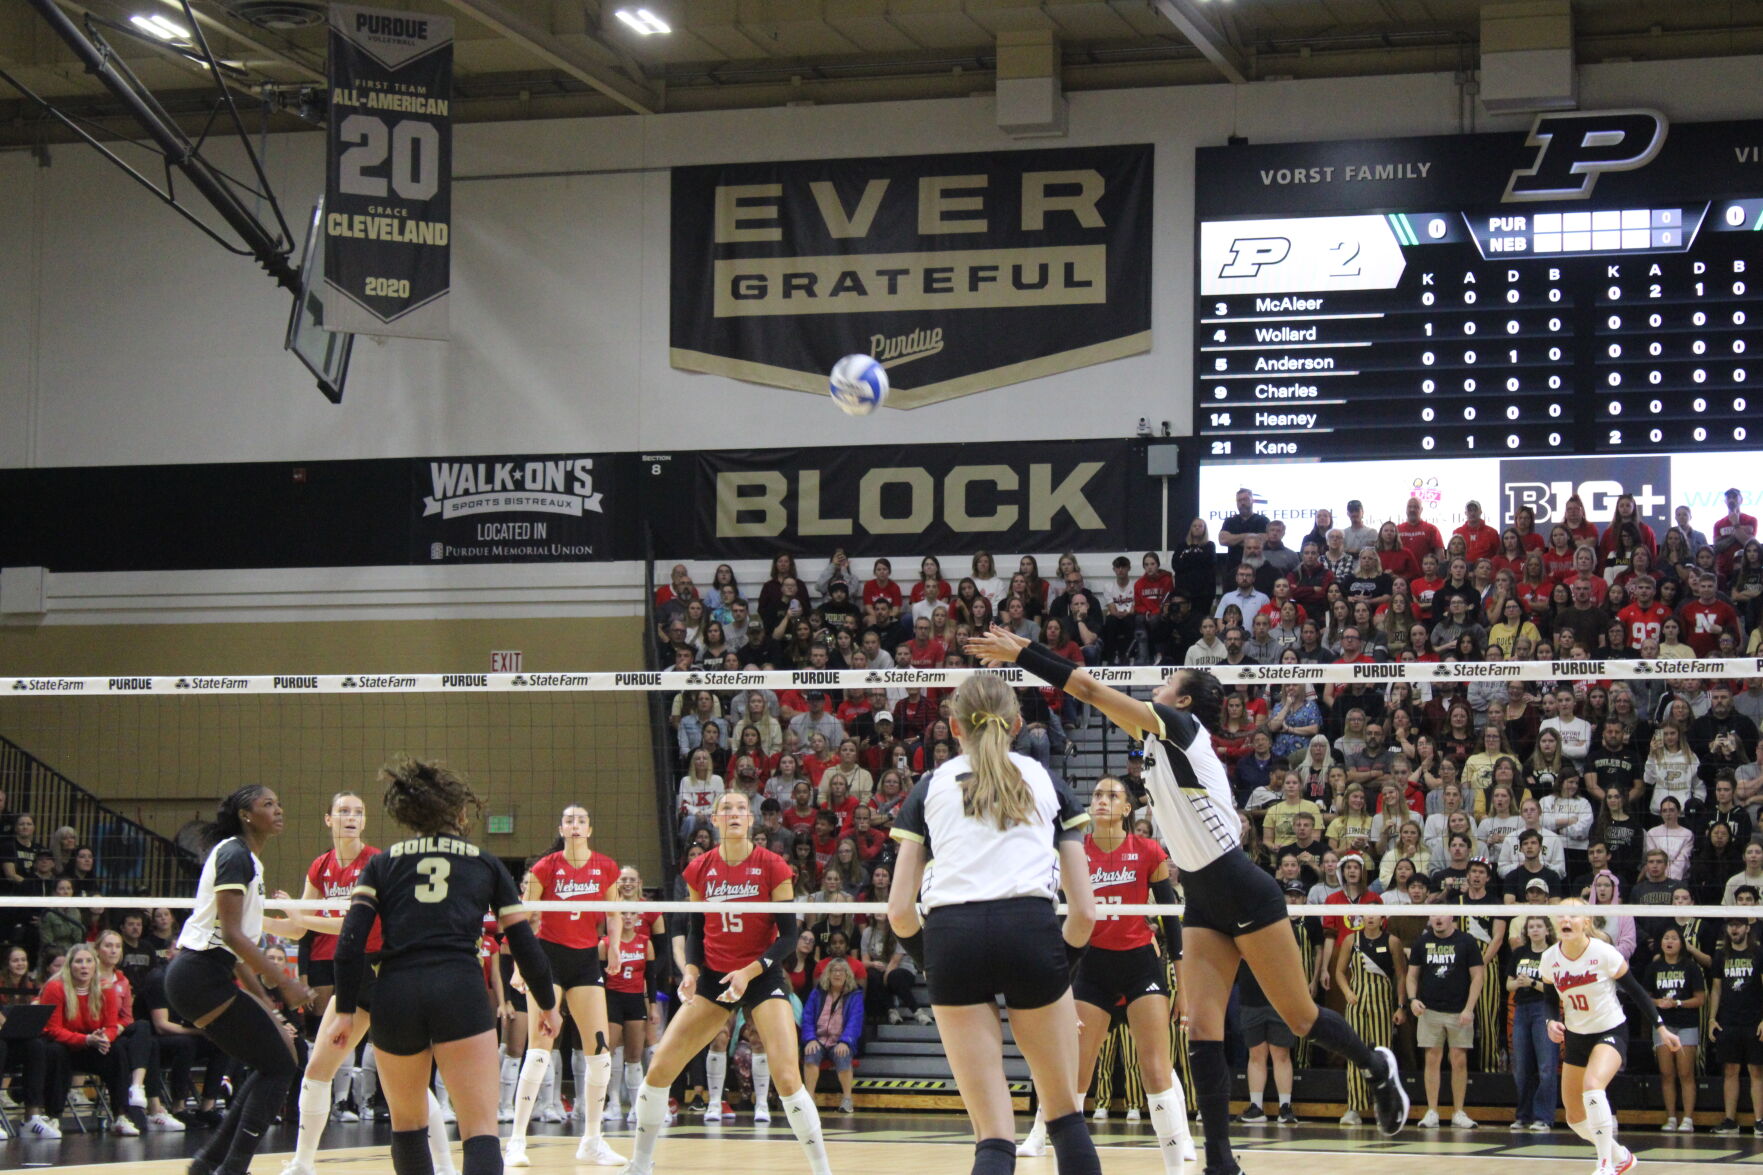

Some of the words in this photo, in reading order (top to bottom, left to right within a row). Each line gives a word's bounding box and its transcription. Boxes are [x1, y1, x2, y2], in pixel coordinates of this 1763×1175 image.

[355, 13, 428, 40] PURDUE
[355, 78, 389, 90] FIRST
[394, 83, 427, 95] TEAM
[332, 87, 448, 117] ALL-AMERICAN
[339, 113, 440, 201] 20
[1260, 166, 1335, 186] VORST
[1345, 162, 1431, 182] FAMILY
[368, 205, 408, 217] GRACE
[714, 168, 1106, 244] EVER
[1489, 216, 1526, 232] PUR
[1661, 210, 1672, 224] 0
[1726, 205, 1745, 226] 0
[327, 212, 448, 246] CLEVELAND
[1428, 218, 1447, 239] 0
[1489, 236, 1527, 252] NEB
[1661, 231, 1672, 245] 0
[1422, 273, 1434, 286] K
[1463, 271, 1476, 284] A
[1507, 269, 1519, 282] D
[1549, 268, 1561, 281] B
[1608, 265, 1619, 278] K
[1649, 263, 1662, 276] A
[1693, 262, 1706, 274] D
[1733, 260, 1745, 273] B
[364, 276, 410, 299] 2020
[731, 261, 1093, 301] GRATEFUL
[1608, 287, 1620, 300] 0
[1650, 285, 1661, 297] 2
[1696, 283, 1703, 296] 1
[1733, 283, 1745, 295] 0
[1215, 302, 1228, 316] 3
[1255, 296, 1324, 312] McAleer
[1422, 292, 1434, 305] 0
[1465, 291, 1476, 303] 0
[1507, 290, 1519, 303] 0
[1549, 289, 1560, 301] 0
[1608, 316, 1620, 329] 0
[1650, 314, 1661, 327] 0
[1693, 312, 1705, 325] 0
[1733, 312, 1745, 324] 0
[1213, 329, 1227, 343] 4
[1254, 326, 1317, 342] Wollard
[1425, 323, 1432, 336] 1
[1464, 322, 1475, 334] 0
[1507, 321, 1519, 334] 0
[1549, 318, 1560, 331] 0
[870, 327, 944, 366] Purdue
[1609, 344, 1621, 357] 0
[1650, 343, 1661, 355] 0
[1693, 341, 1705, 354] 0
[1733, 340, 1745, 353] 0
[1214, 357, 1228, 371] 5
[1254, 355, 1334, 371] Anderson
[1423, 352, 1434, 365] 0
[1465, 351, 1476, 363] 0
[1510, 350, 1517, 363] 1
[1549, 348, 1560, 360] 0
[1609, 373, 1621, 386] 0
[1650, 371, 1661, 384] 0
[1694, 369, 1706, 383] 0
[1734, 369, 1745, 382] 0
[1214, 385, 1228, 399] 9
[1254, 382, 1318, 399] Charles
[1423, 380, 1434, 393] 0
[1464, 379, 1475, 392] 0
[1507, 378, 1519, 391] 0
[1549, 376, 1560, 388] 0
[1609, 402, 1621, 415] 0
[1650, 400, 1662, 413] 0
[1694, 399, 1706, 412] 0
[1734, 398, 1745, 411] 0
[1210, 412, 1232, 427] 14
[1255, 412, 1317, 429] Heaney
[1422, 408, 1434, 421] 0
[1464, 407, 1475, 420] 0
[1507, 406, 1519, 419] 0
[1549, 404, 1561, 417] 0
[1211, 441, 1232, 455] 21
[1254, 440, 1298, 455] Kane
[1422, 437, 1434, 450] 0
[1467, 436, 1473, 448] 1
[1507, 435, 1519, 448] 0
[1549, 433, 1560, 446] 0
[1610, 431, 1621, 444] 2
[1650, 429, 1662, 442] 0
[1694, 428, 1706, 441] 0
[1734, 427, 1746, 440] 0
[651, 464, 661, 475] 8
[430, 462, 515, 500] WALK
[452, 498, 500, 512] SPORTS
[504, 497, 572, 509] BISTREAUX
[716, 461, 1106, 538] BLOCK
[1273, 508, 1338, 520] FEDERL
[477, 523, 530, 541] LOCATED
[534, 523, 547, 539] IN
[491, 652, 522, 673] EXIT
[1354, 664, 1405, 678] PURDUE
[1552, 661, 1605, 676] PURDUE
[109, 678, 151, 690] PURDUE
[274, 676, 317, 689] PURDUE
[443, 674, 487, 687] PURDUE
[616, 673, 661, 686] PURDUE
[793, 671, 839, 685] PURDUE
[390, 840, 480, 859] BOILERS
[414, 857, 452, 903] 3
[1090, 865, 1137, 885] ebraska
[554, 879, 600, 895] Nebraska
[705, 879, 760, 898] Nebraska
[720, 911, 744, 933] 15
[1427, 945, 1456, 954] BLOCK
[1426, 954, 1456, 964] PARTY
[1724, 959, 1753, 969] BLOCK
[1656, 970, 1685, 979] BLOCK
[1724, 968, 1754, 977] PARTY
[1656, 979, 1686, 989] PARTY
[1568, 994, 1590, 1011] 10
